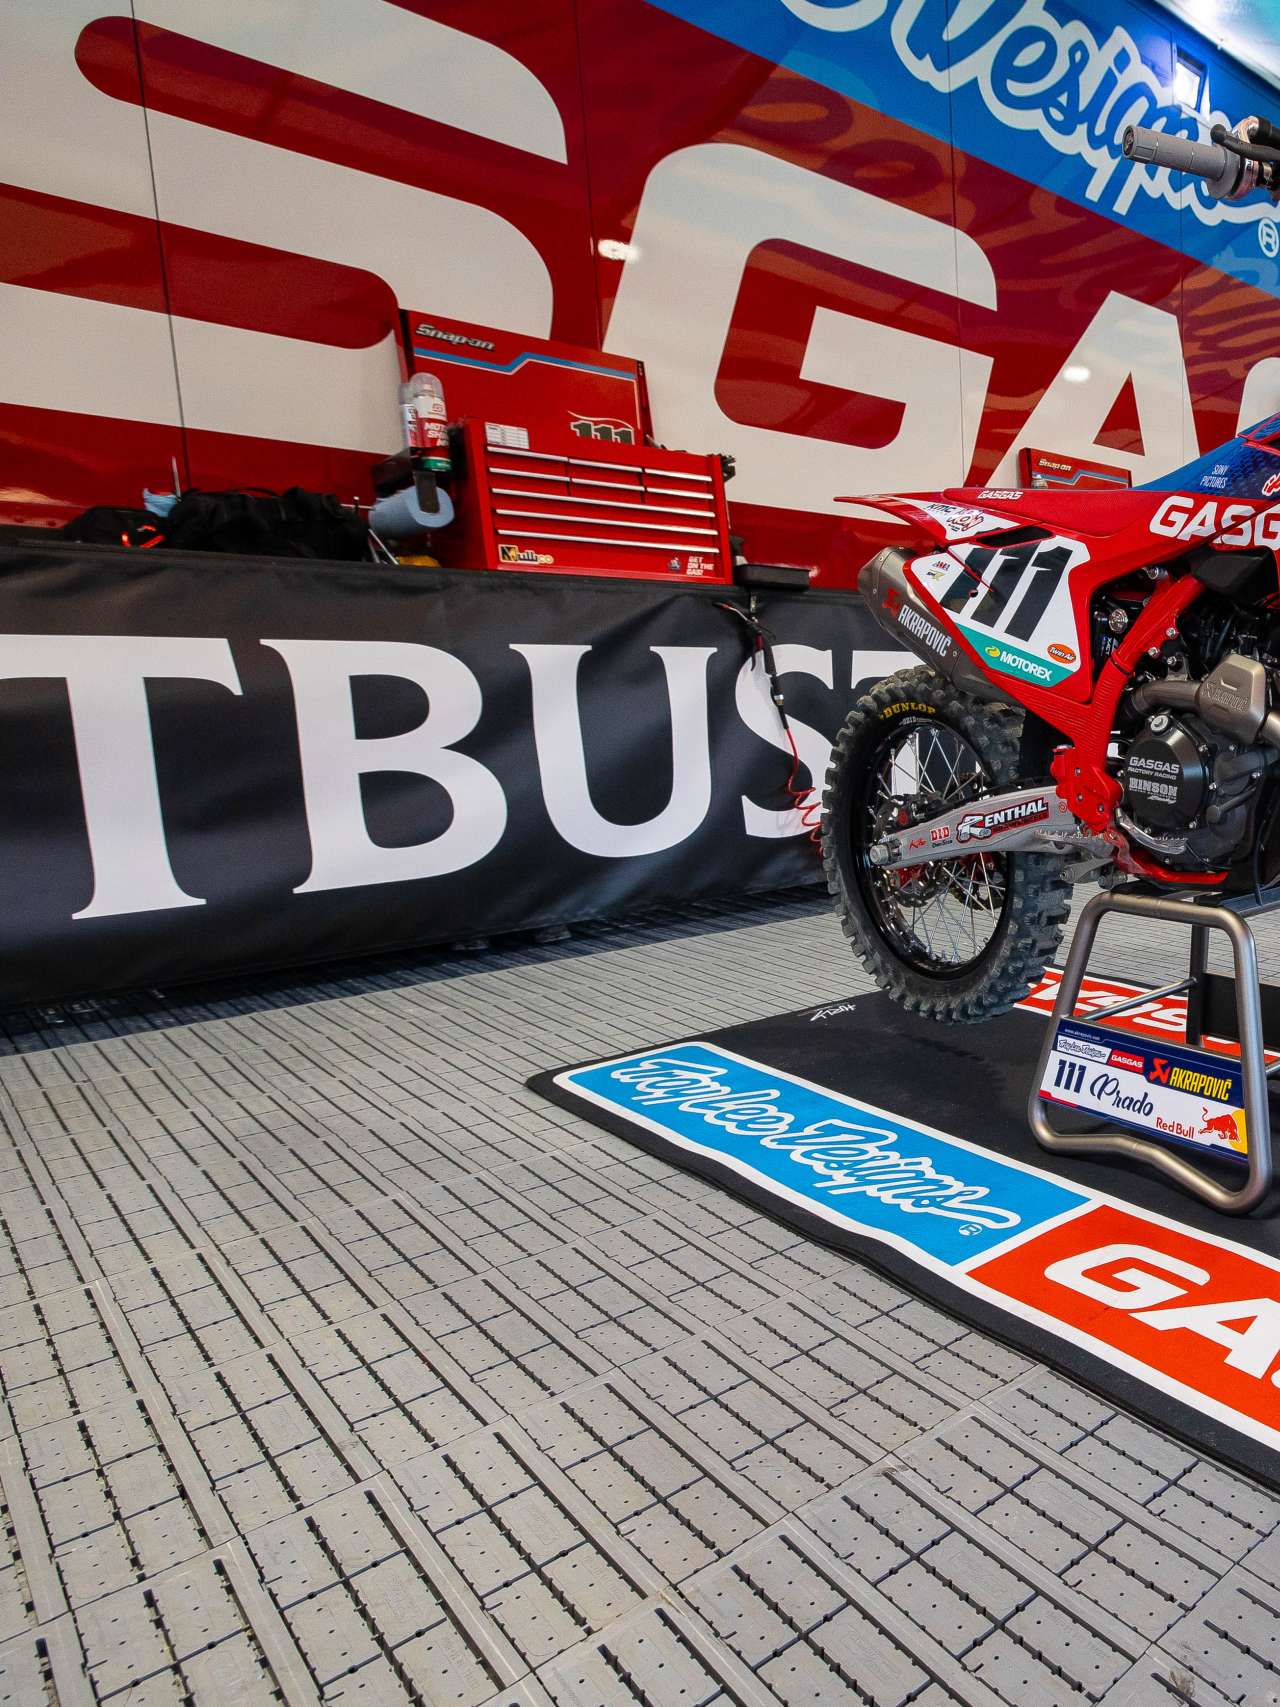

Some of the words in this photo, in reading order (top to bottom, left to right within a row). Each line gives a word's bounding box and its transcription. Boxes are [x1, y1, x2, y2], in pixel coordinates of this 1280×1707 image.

[415, 323, 496, 350] Snap-on
[1211, 464, 1229, 476] SONY
[1199, 474, 1229, 489] PICTURES
[978, 490, 1024, 500] GASGAS
[938, 544, 1074, 643] 111
[1000, 650, 1053, 682] MOTOREX
[885, 702, 936, 718] DUNLOP
[1130, 756, 1180, 774] GASGAS
[1129, 777, 1178, 797] HINSON
[957, 799, 1048, 844] RENTHAL
[1111, 1054, 1144, 1068] GASGAS
[1053, 1058, 1087, 1094] 111
[1089, 1073, 1154, 1117] Prado
[1169, 1066, 1233, 1101] AKRAPOVIČ
[1156, 1116, 1176, 1134] Red
[1175, 1121, 1195, 1140] Bull
